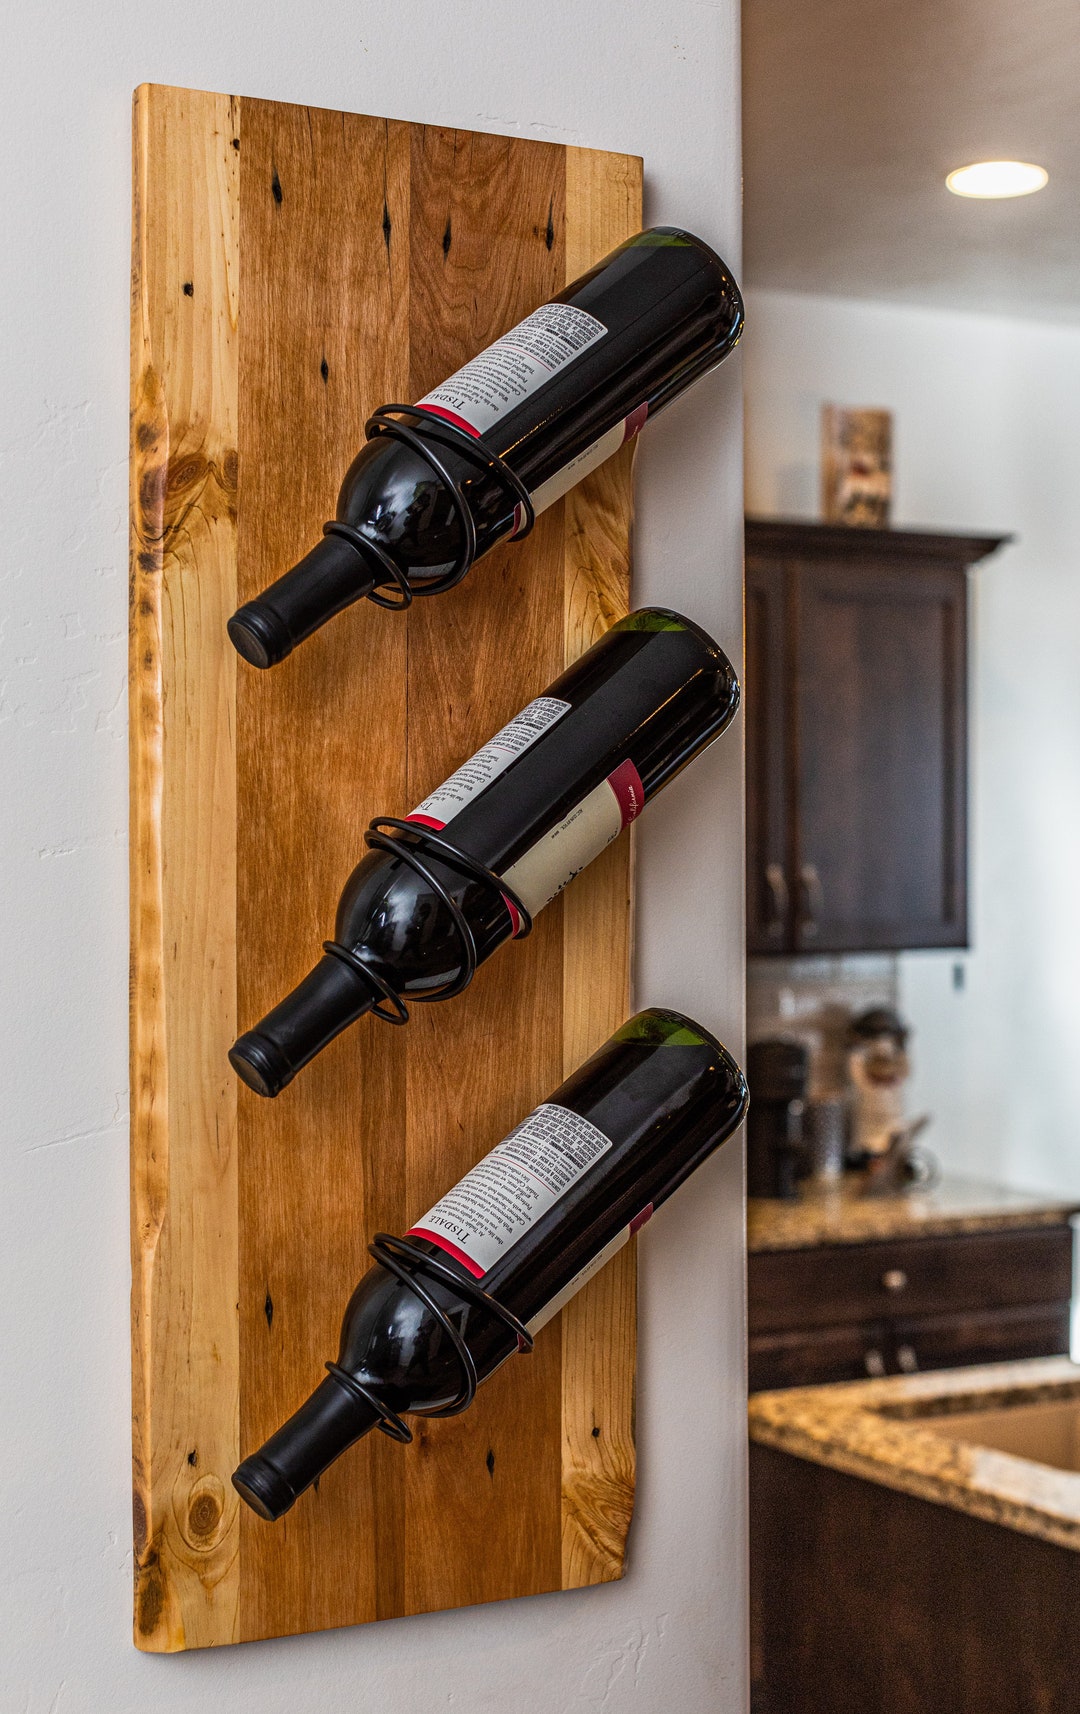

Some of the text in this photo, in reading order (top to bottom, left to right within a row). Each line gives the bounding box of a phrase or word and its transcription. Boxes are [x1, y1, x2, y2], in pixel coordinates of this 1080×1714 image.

[524, 1184, 540, 1199] Tisdale
[513, 1193, 532, 1210] Perfectly
[506, 1207, 525, 1226] Cabernet
[428, 1215, 470, 1244] TISDALE
[501, 1221, 513, 1233] With
[493, 1235, 503, 1245] that
